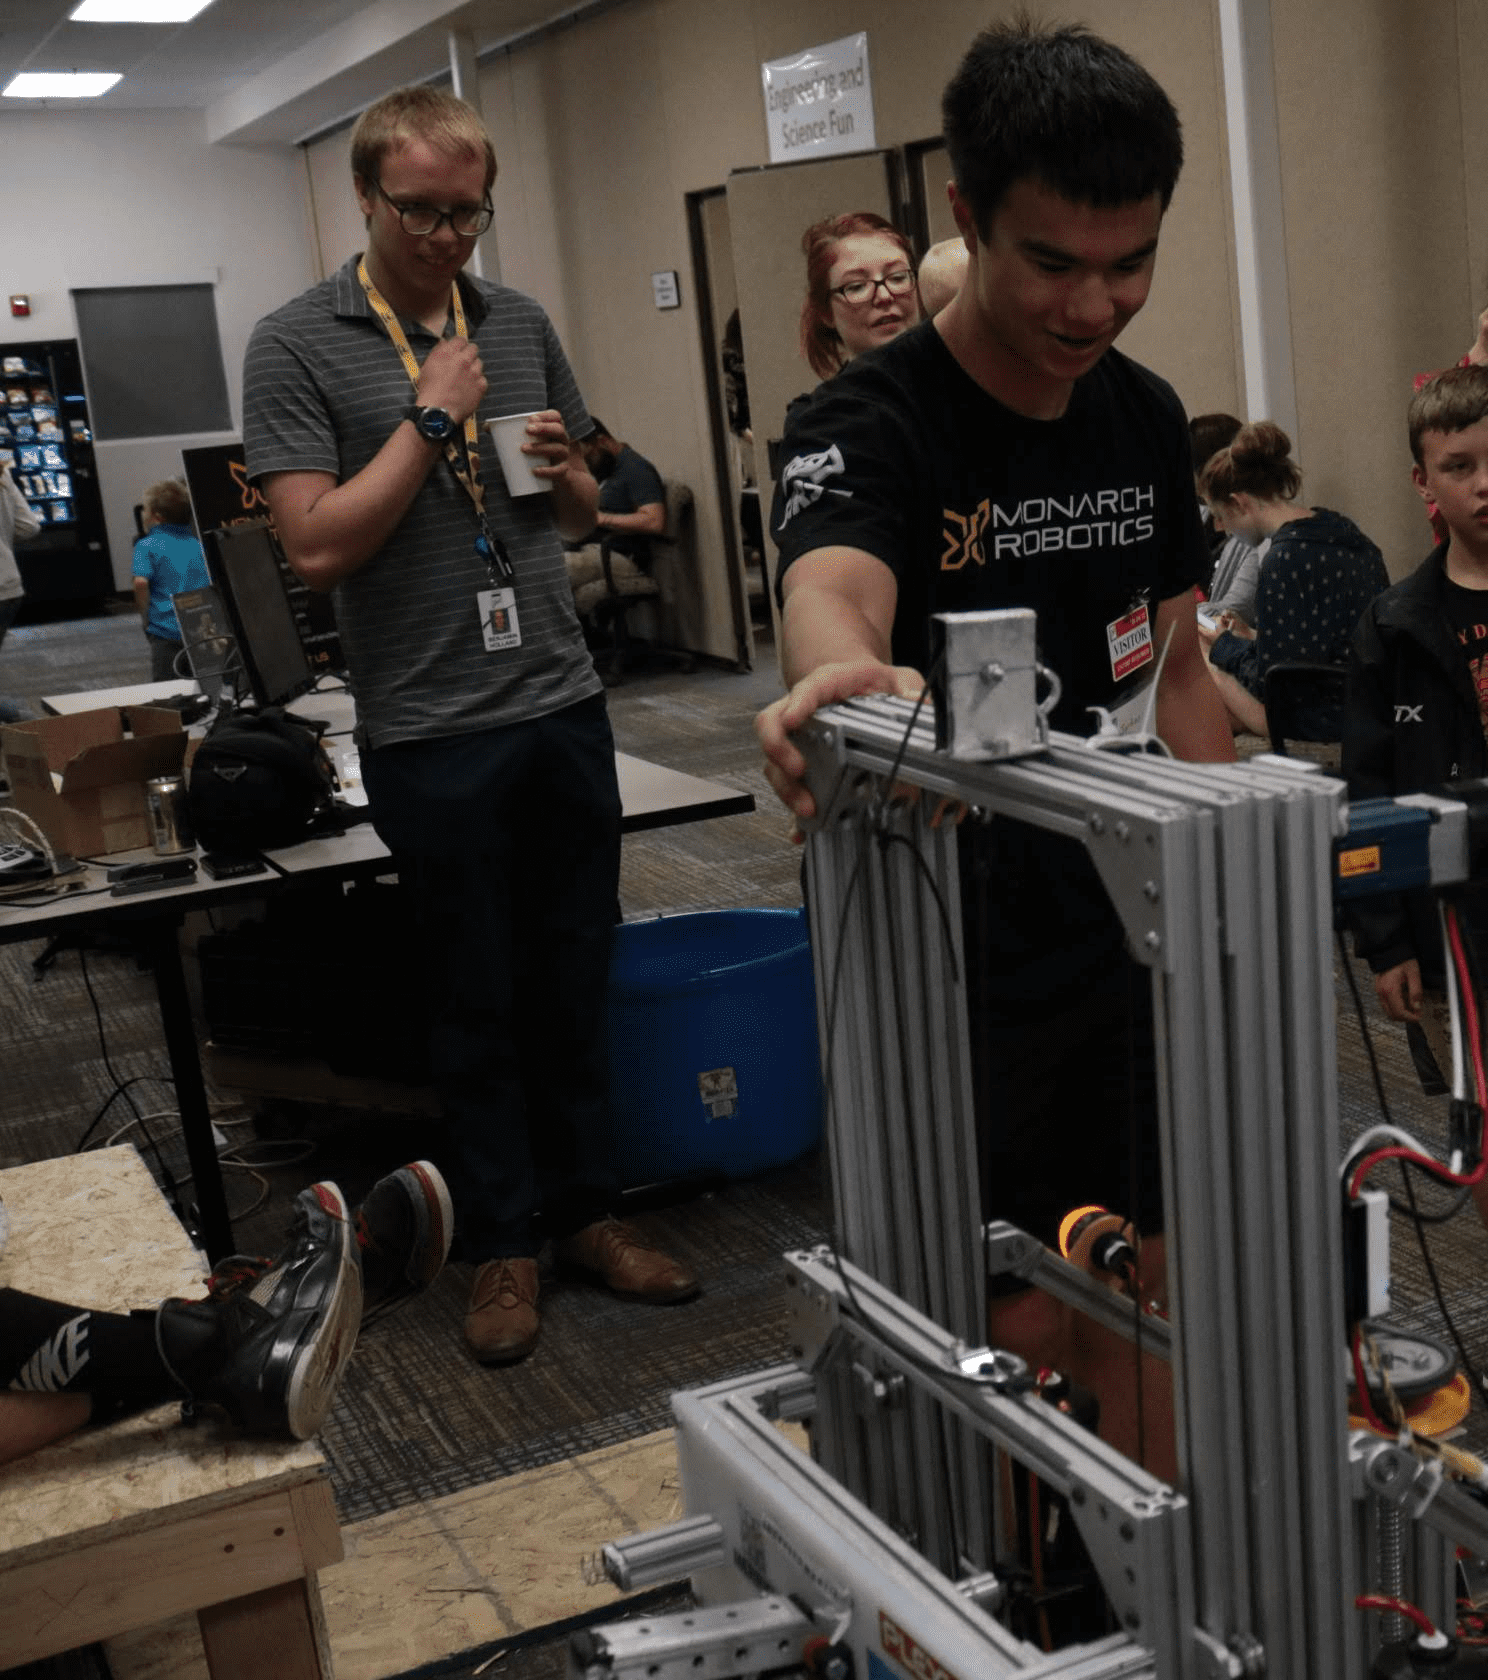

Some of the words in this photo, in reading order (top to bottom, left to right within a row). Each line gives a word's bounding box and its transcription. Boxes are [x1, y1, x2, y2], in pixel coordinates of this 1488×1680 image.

[769, 69, 837, 114] Engineering
[839, 56, 865, 92] and
[782, 119, 827, 149] Science
[829, 108, 855, 137] Fun
[992, 484, 1155, 529] MONARCH
[993, 514, 1155, 561] ROBOTICS
[1113, 627, 1148, 657] VISITOR
[1393, 704, 1424, 723] TX
[8, 1311, 92, 1393] NIKE
